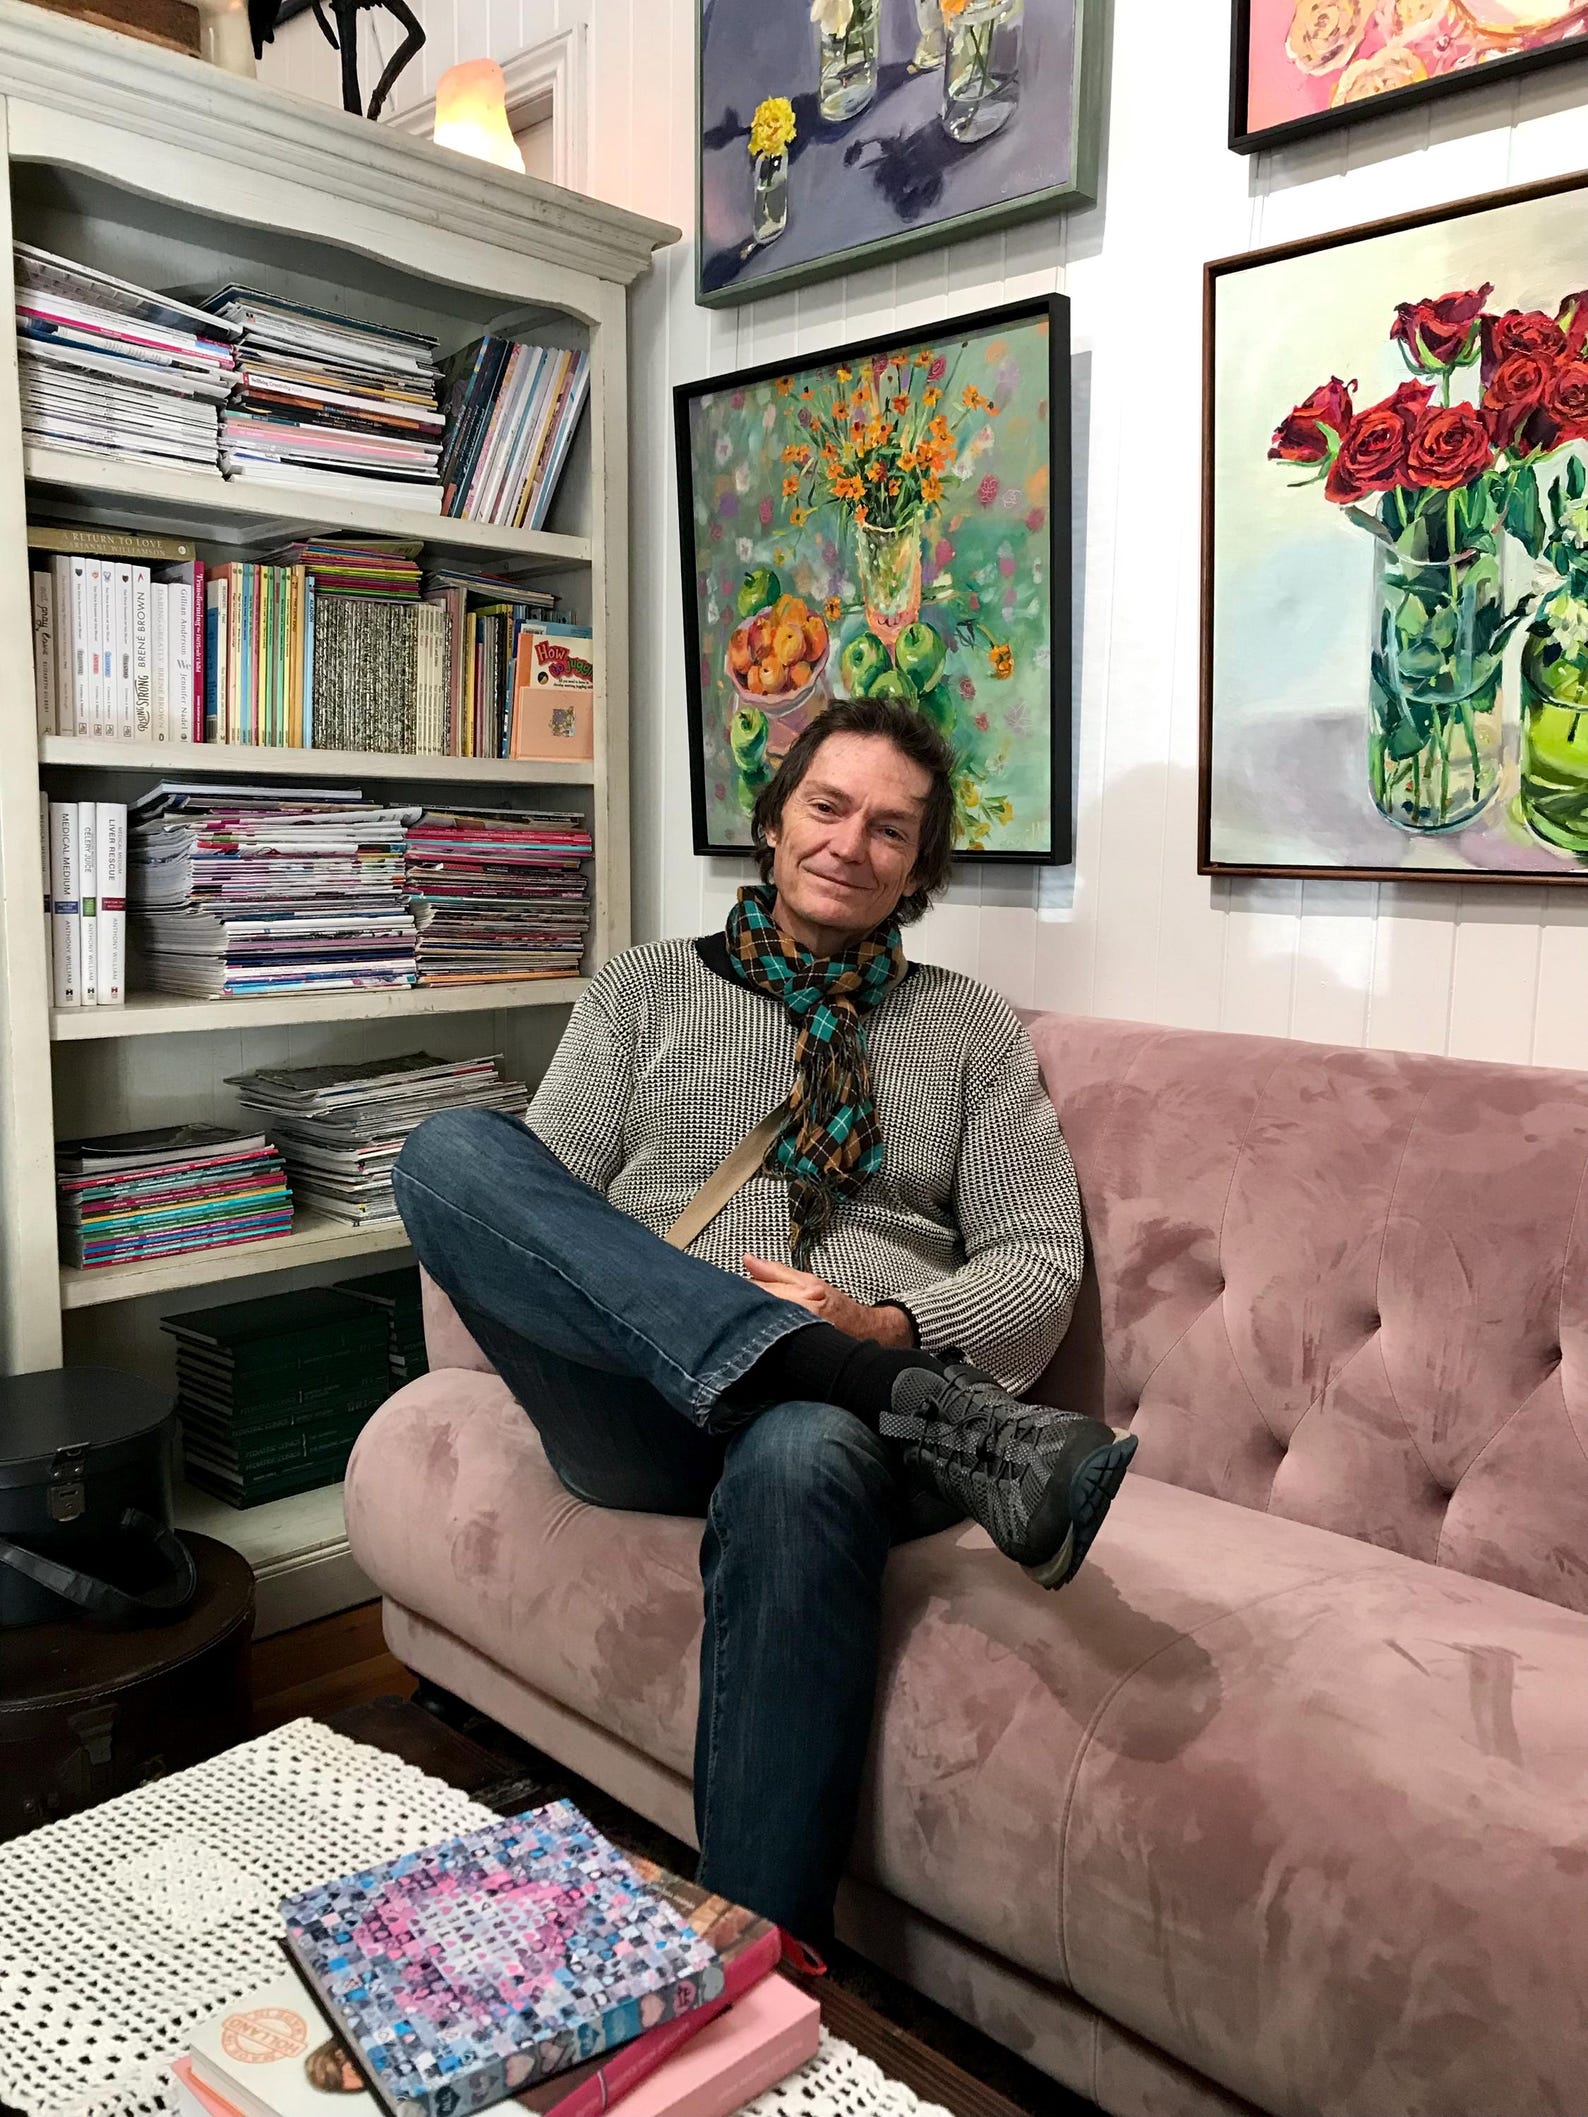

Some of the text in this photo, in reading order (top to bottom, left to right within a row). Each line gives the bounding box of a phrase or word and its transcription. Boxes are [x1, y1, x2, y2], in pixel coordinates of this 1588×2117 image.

[72, 532, 114, 544] RETURN
[118, 536, 133, 545] TO
[136, 538, 163, 548] LOVE
[111, 545, 166, 556] WILLIAMSON
[137, 592, 145, 631] BROWN
[157, 589, 165, 624] DARING
[180, 589, 188, 616] Gillian
[195, 573, 204, 628] Transforming
[36, 605, 49, 631] pray
[42, 632, 51, 656] love
[157, 624, 165, 664] GREATLY
[537, 643, 565, 661] How
[176, 659, 192, 670] We
[551, 658, 593, 676] to jugg
[135, 675, 150, 732] RISING STRONG
[157, 697, 165, 729] BROWN
[179, 673, 188, 730] Jennifer Nadel
[62, 813, 71, 895] MEDICAL MEDIUM
[84, 853, 92, 873] JUICE
[108, 846, 116, 881] RESCUE
[229, 2019, 300, 2053] HOLLAND
